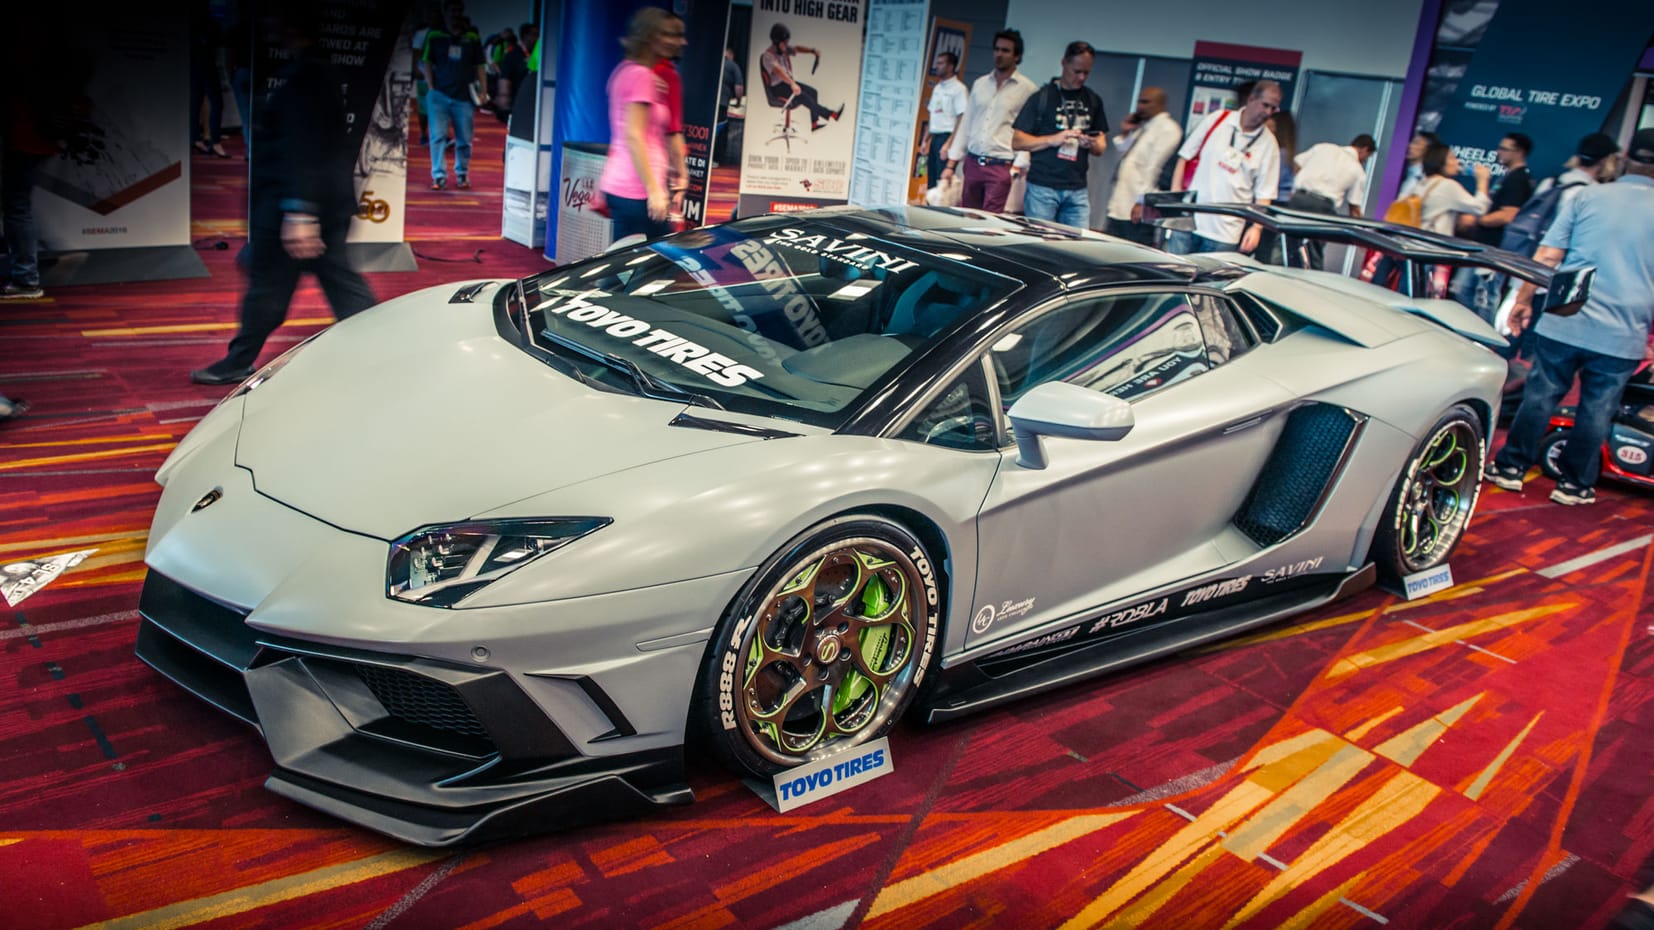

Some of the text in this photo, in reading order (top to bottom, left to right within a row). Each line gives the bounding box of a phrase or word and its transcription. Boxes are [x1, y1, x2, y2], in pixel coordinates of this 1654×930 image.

[760, 0, 858, 23] INTO HIGH GEAR
[330, 54, 368, 66] SHOW
[1197, 62, 1232, 74] OFFICIAL
[1235, 67, 1261, 78] SHOW
[1203, 74, 1231, 84] ENTRY
[1471, 85, 1601, 110] GLOBAL TIRE EXPO
[769, 228, 920, 273] SAVINI
[794, 244, 819, 255] GOLD
[820, 252, 871, 270] STANDARD
[551, 297, 764, 387] TOYO TIRES
[1261, 556, 1324, 582] SAVINI
[1407, 571, 1449, 593] TOYO TIRES
[1180, 574, 1254, 608] TOYO TIRES
[911, 546, 938, 688] TOYO TIRES
[779, 749, 884, 801] TOYO TIRES
